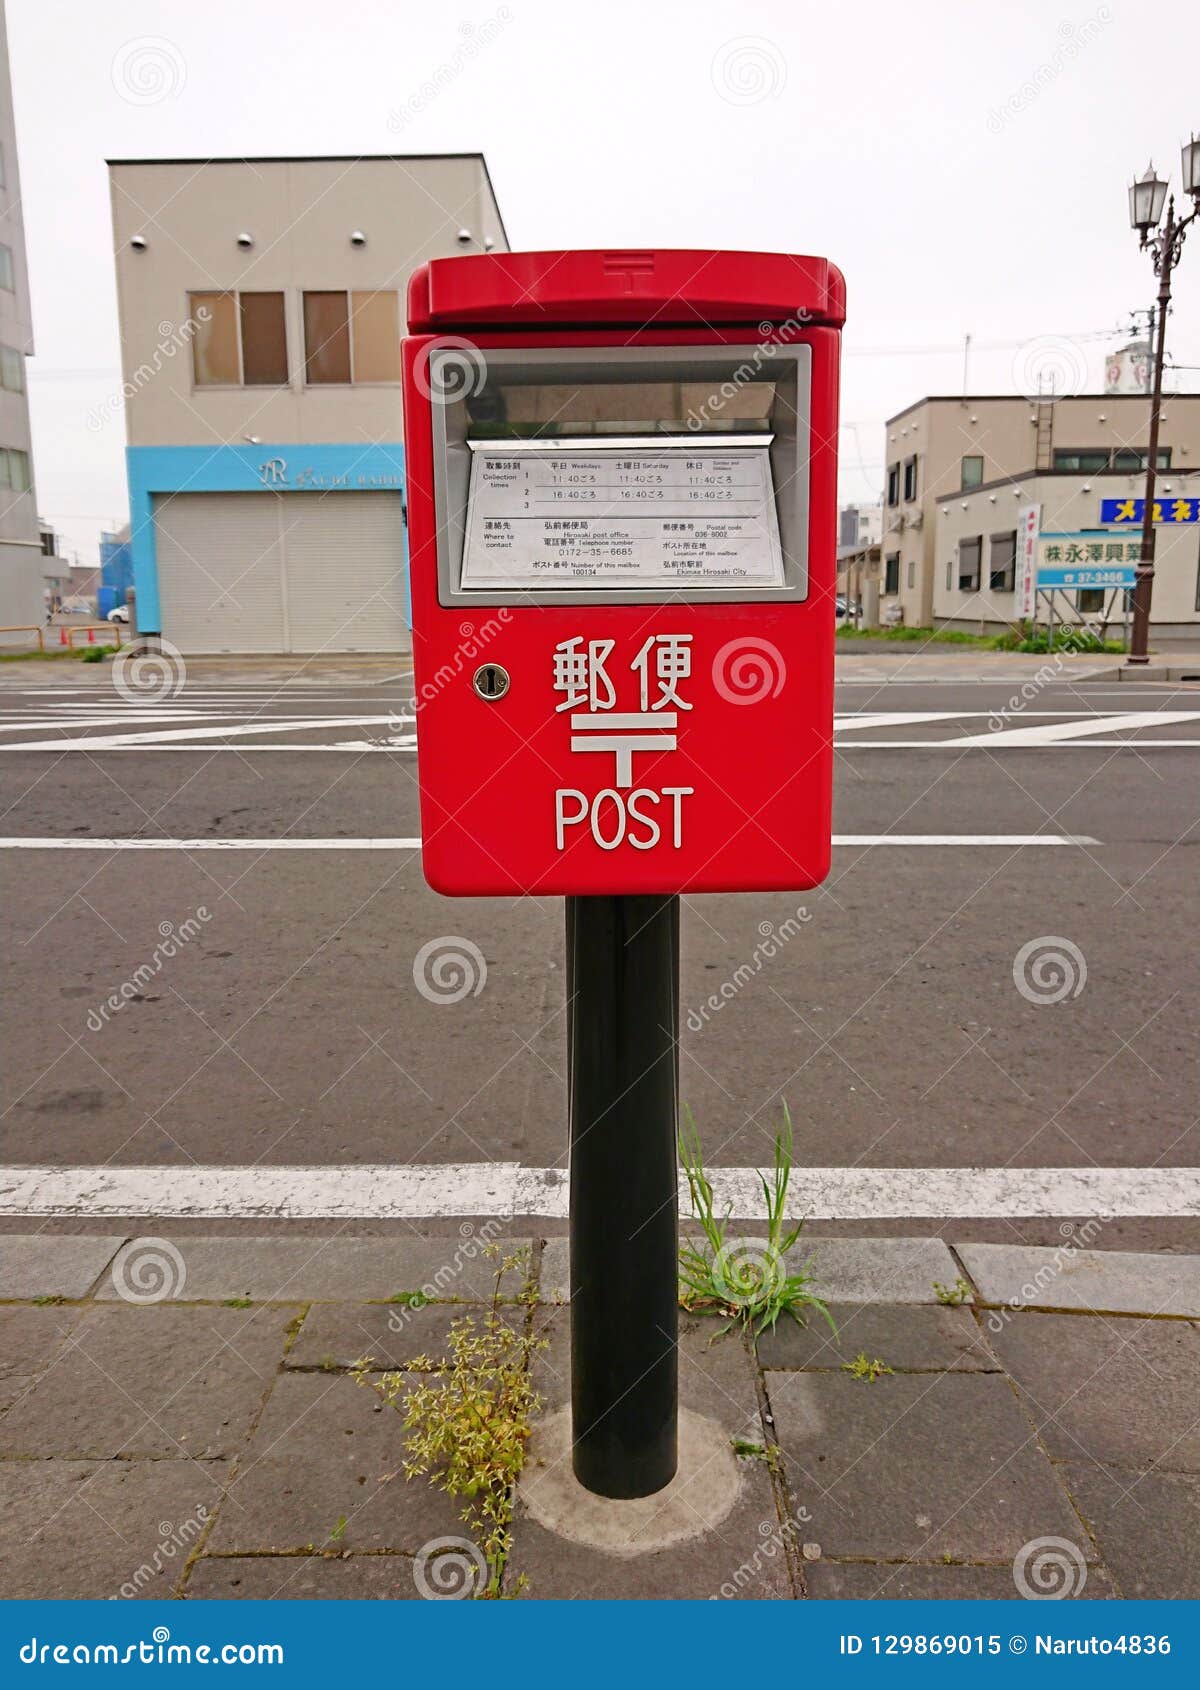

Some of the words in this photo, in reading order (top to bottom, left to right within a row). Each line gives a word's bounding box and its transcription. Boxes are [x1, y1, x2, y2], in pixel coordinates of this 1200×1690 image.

[551, 462, 567, 470] 平日
[615, 462, 641, 470] 土曜日
[686, 462, 703, 470] 休日
[485, 522, 511, 530] 連絡先
[544, 522, 588, 530] 弘前郵便局
[663, 523, 694, 531] 郵便番号
[544, 538, 575, 546] 電話番号
[558, 548, 633, 556] 0172-35-6685
[532, 561, 568, 569] ポスト番号
[732, 568, 747, 576] City
[553, 634, 694, 712] 郵便
[555, 787, 694, 850] POST
